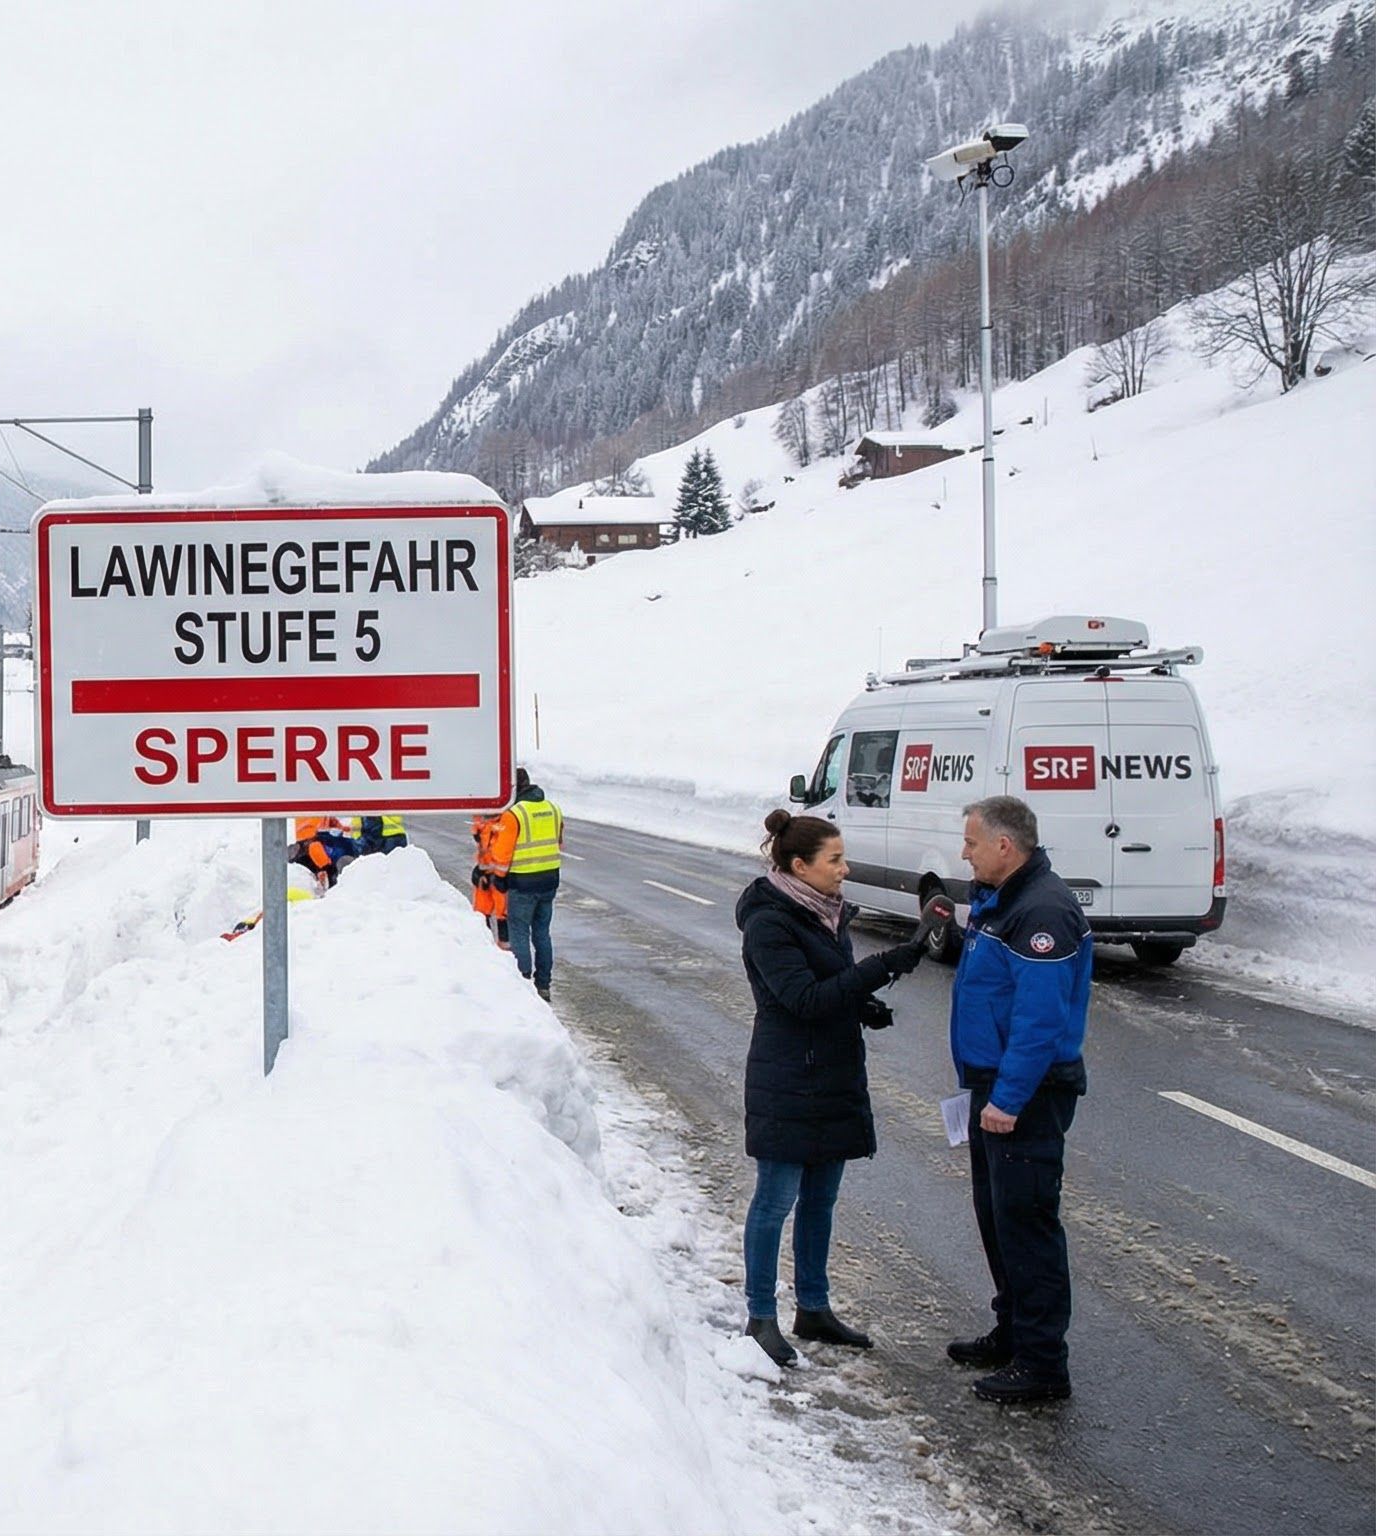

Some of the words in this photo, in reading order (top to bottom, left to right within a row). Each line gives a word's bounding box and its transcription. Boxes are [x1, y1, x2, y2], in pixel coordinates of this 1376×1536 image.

[70, 538, 480, 598] LAWINEGEFAHR
[174, 610, 337, 665] STUFE
[355, 610, 381, 663] 5
[134, 724, 431, 785] SPERRE
[904, 756, 929, 780] SRF
[930, 754, 975, 783] NEWS
[1032, 756, 1089, 781] SRF
[1101, 754, 1193, 781] NEWS
